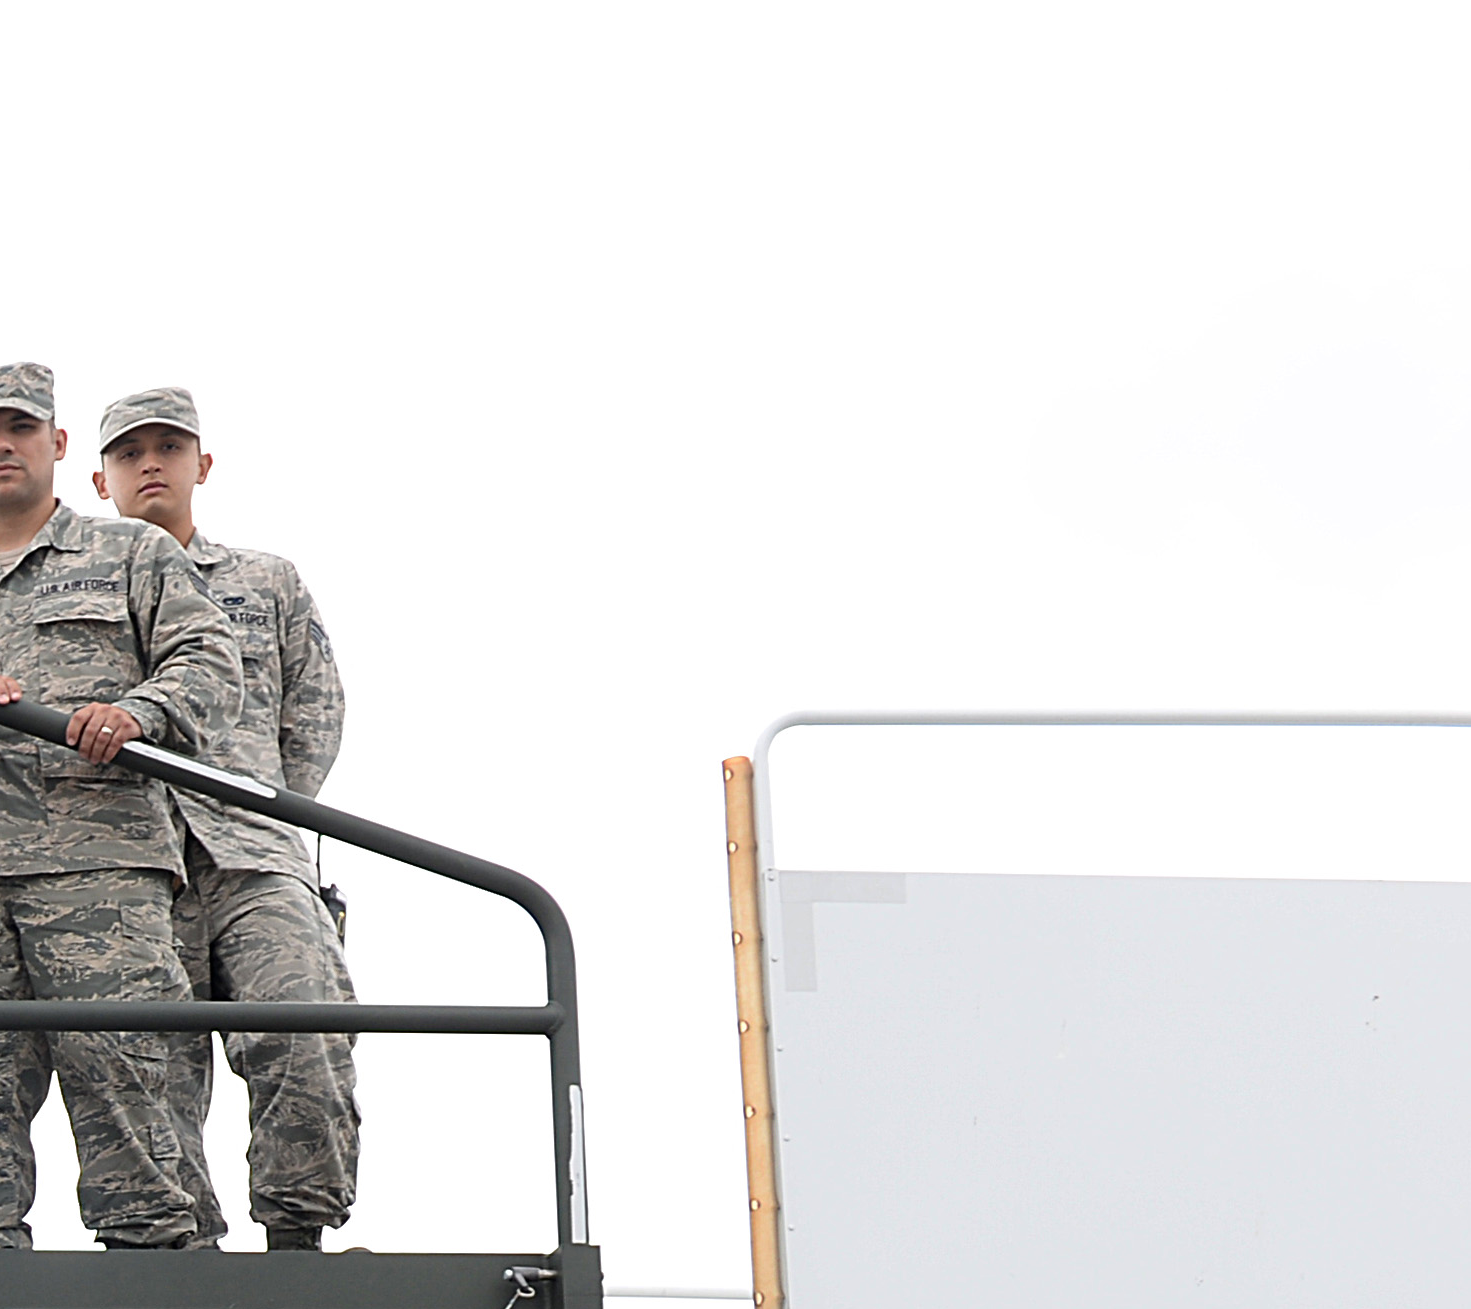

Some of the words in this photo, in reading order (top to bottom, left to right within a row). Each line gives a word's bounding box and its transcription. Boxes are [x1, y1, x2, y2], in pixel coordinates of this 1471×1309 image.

[40, 584, 60, 596] U.S.
[63, 580, 83, 592] AIR
[84, 579, 120, 592] FORCE
